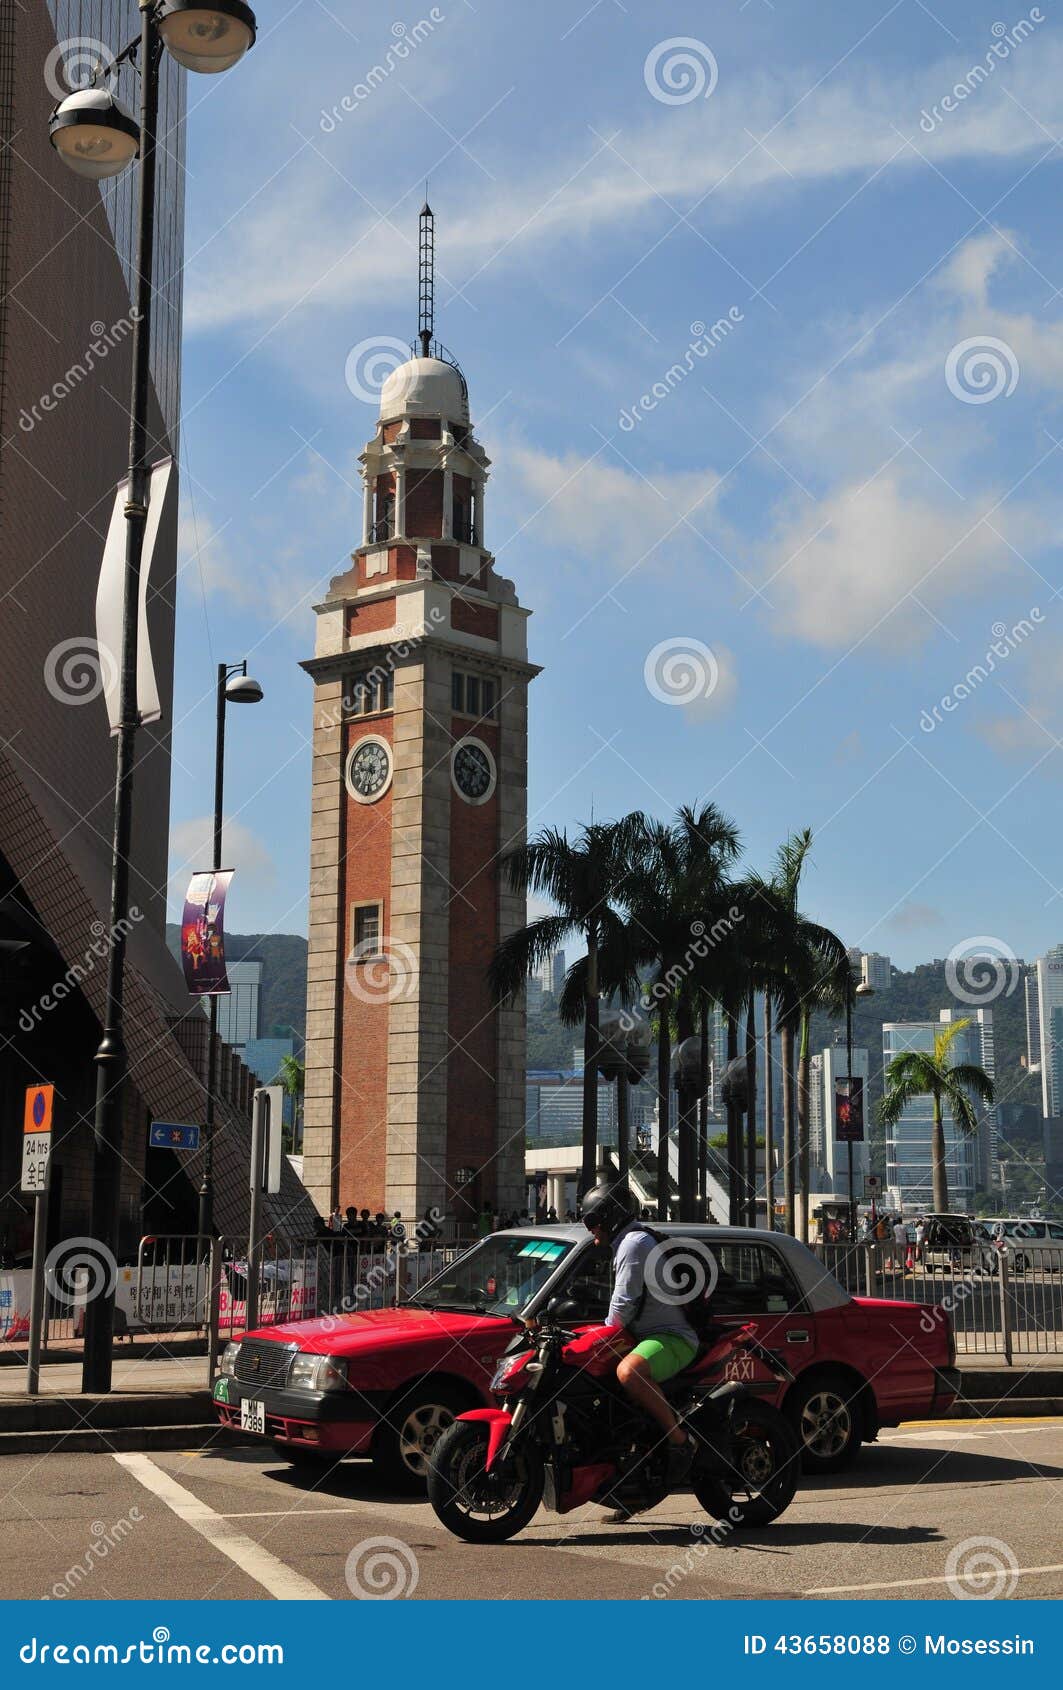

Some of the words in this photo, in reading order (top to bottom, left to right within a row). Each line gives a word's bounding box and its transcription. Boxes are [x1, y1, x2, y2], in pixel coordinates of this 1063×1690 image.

[26, 1140, 36, 1156] 24
[37, 1139, 48, 1155] hrs
[27, 1161, 45, 1187] 全日
[725, 1361, 755, 1380] TAXI
[243, 1413, 263, 1433] 7389
